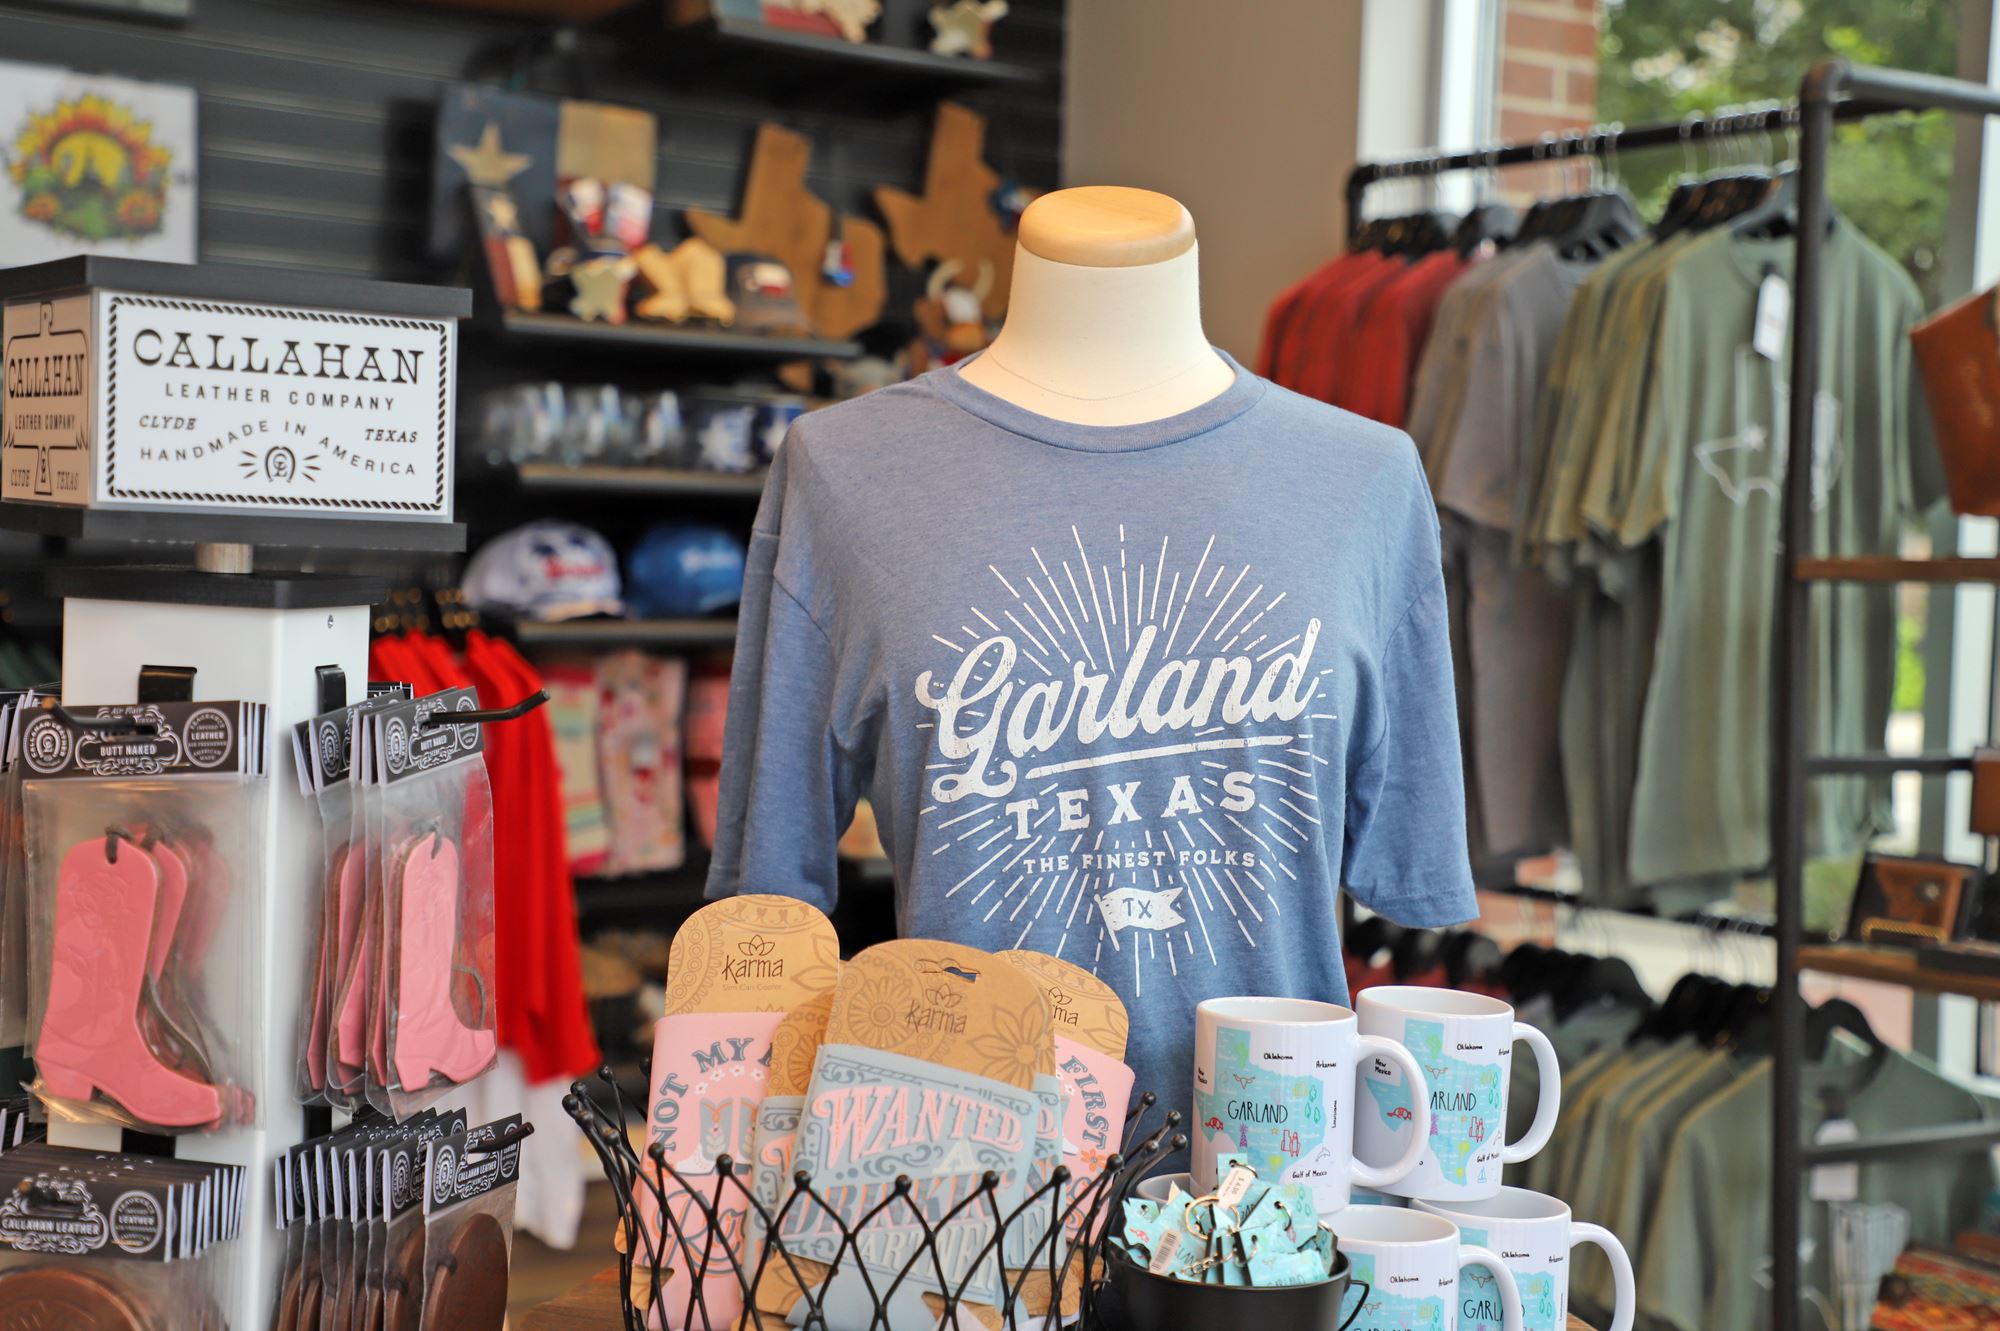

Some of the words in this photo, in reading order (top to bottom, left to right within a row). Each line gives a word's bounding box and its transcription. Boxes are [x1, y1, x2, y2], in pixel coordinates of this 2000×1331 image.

[133, 328, 424, 385] CALLAHAN
[8, 353, 85, 399] CALLAHAN
[165, 382, 270, 403] LEATHER
[289, 390, 396, 412] COMPANY
[15, 414, 42, 430] LEATHER
[45, 413, 76, 430] COMPANY
[139, 414, 197, 431] CLYDE
[365, 428, 419, 444] TEXAS
[140, 420, 269, 461] HANDMADE
[285, 421, 307, 436] IN
[318, 435, 417, 476] AMERICA
[10, 468, 31, 487] CLYDE
[56, 470, 80, 491] TEXAS
[914, 617, 1322, 804] Garland
[191, 731, 225, 740] LEATHER
[100, 744, 123, 757] BUTT
[125, 743, 158, 756] NAKED
[1005, 771, 1257, 840] TEXAS
[1022, 854, 1070, 875] THE
[1081, 850, 1165, 870] FINEST
[1179, 848, 1257, 868] FOLKS
[1122, 897, 1153, 919] TX
[721, 954, 784, 984] karma
[903, 1000, 968, 1034] karma
[1263, 1052, 1294, 1061] Oklahoma
[1456, 1043, 1483, 1051] Oklahoma
[1374, 1058, 1387, 1068] New
[1374, 1066, 1392, 1076] Mexico
[651, 1072, 689, 1153] NOT
[691, 1037, 755, 1073] MY
[1060, 1055, 1110, 1150] FIRST
[1430, 1090, 1477, 1112] ARLAND
[1227, 1099, 1289, 1124] GARLAND
[810, 1085, 1024, 1168] WANTED
[1292, 1170, 1305, 1179] Gulf
[1305, 1170, 1311, 1178] of
[1312, 1170, 1328, 1178] Mexico
[2, 1218, 55, 1232] CALLAHAN
[56, 1221, 100, 1235] LEATHER
[118, 1215, 154, 1226] LEATHER
[1501, 1251, 1531, 1259] Oklahoma
[1389, 1275, 1420, 1284] Oklahoma
